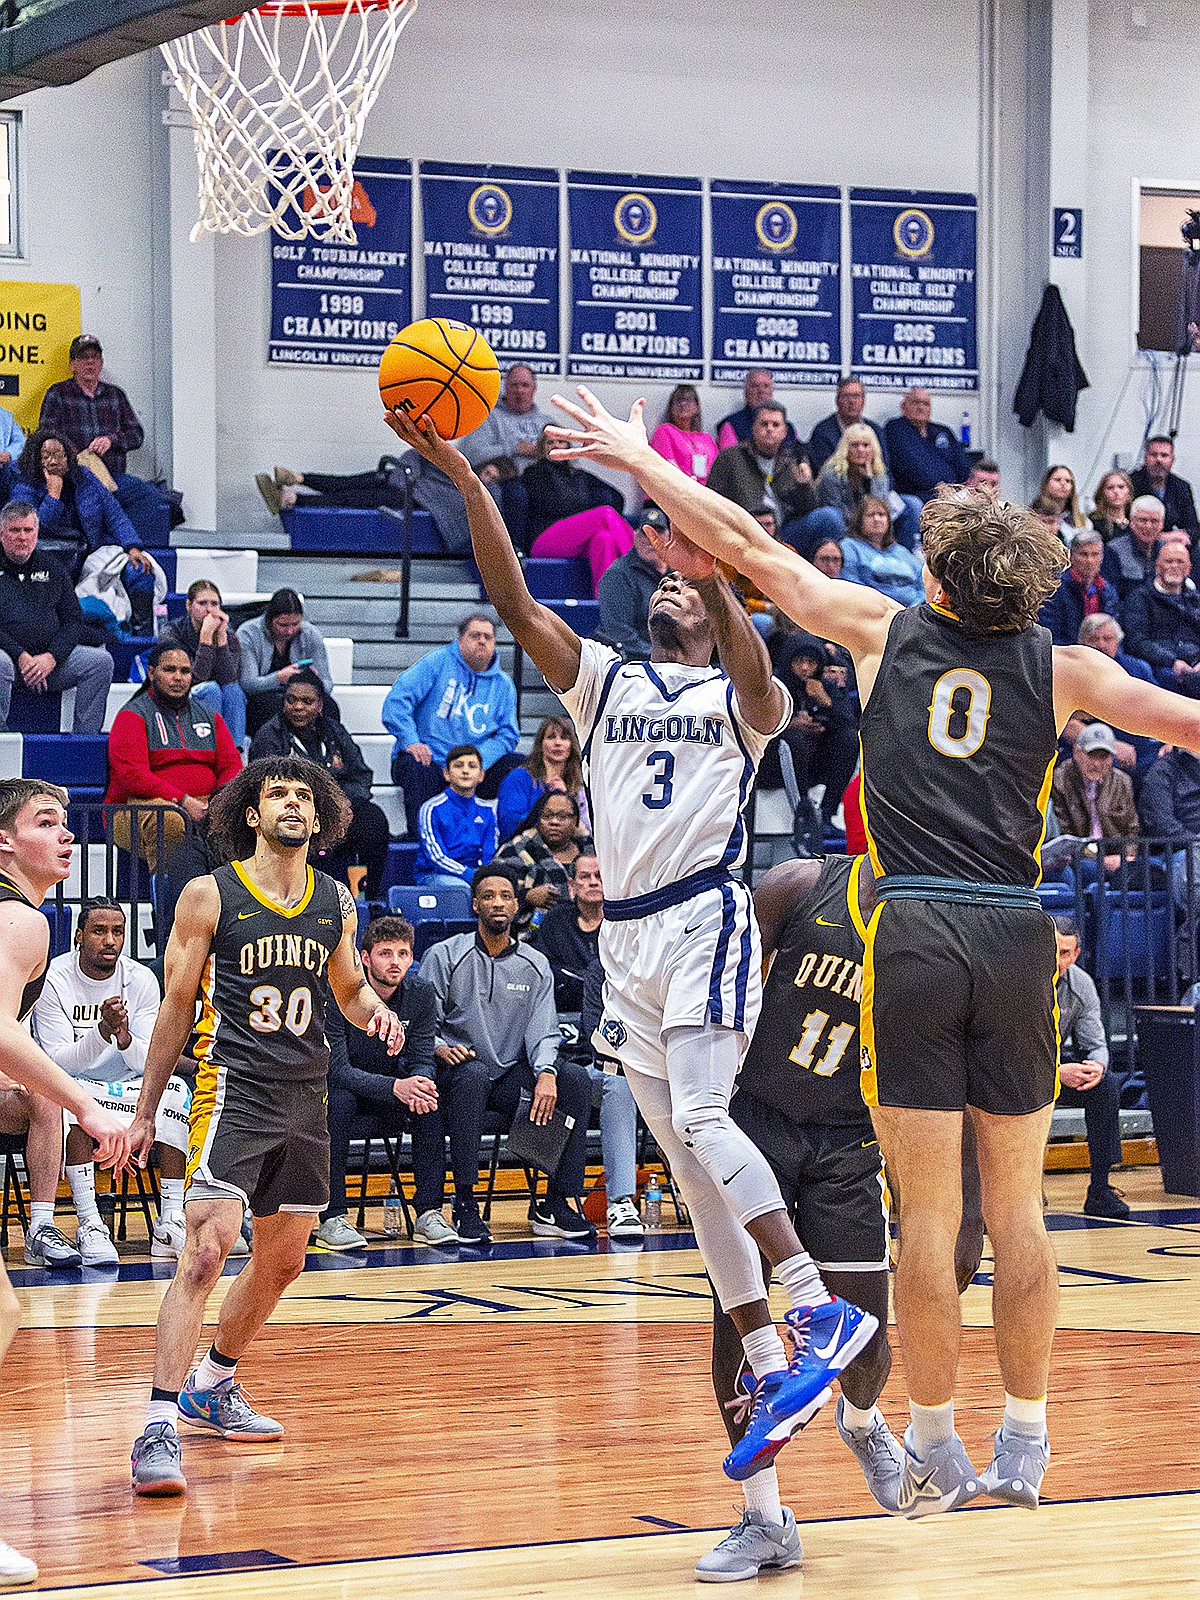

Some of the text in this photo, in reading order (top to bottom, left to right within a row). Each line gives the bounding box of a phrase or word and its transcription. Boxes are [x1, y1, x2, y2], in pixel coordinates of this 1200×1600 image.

[1060, 212, 1076, 243] 2
[273, 245, 407, 267] GOLF TOURNAMENT
[423, 241, 557, 262] NATIONAL MINORITY
[571, 249, 701, 269] NATIONAL MINORITY
[297, 264, 384, 282] CHAMPIONSHIP
[443, 259, 538, 278] COLLEGE GOLF
[589, 266, 682, 286] COLLEGE GOLF
[713, 256, 838, 276] NATIONAL MINORITY
[852, 263, 976, 283] NATIONAL MINORITY
[445, 276, 536, 295] CHAMPIONSHIP
[591, 283, 680, 302] CHAMPIONSHIP
[731, 274, 822, 292] COLLEGE GOLF
[870, 280, 957, 298] COLLEGE GOLF
[319, 293, 364, 315] 1998
[734, 290, 820, 308] CHAMPIONSHIP
[872, 296, 956, 314] CHAMPIONSHIP
[471, 303, 514, 325] 1999
[614, 310, 658, 332] 2001
[282, 315, 399, 341] CHAMPIONS
[580, 332, 691, 357] CHAMPIONS
[723, 338, 831, 362] CHAMPIONS
[271, 348, 329, 363] LINCOLN
[862, 344, 966, 368] CHAMPIONS
[570, 362, 626, 377] LINCOLN
[626, 365, 701, 380] UNIVERSITY
[906, 376, 976, 391] UNIVERSITY
[926, 667, 993, 759] 0
[604, 715, 725, 747] LINCOLN
[642, 750, 676, 810] 3
[239, 933, 330, 978] QUINCY
[793, 952, 864, 1004] QUIN
[248, 984, 313, 1037] 30
[787, 1008, 857, 1078] 11
